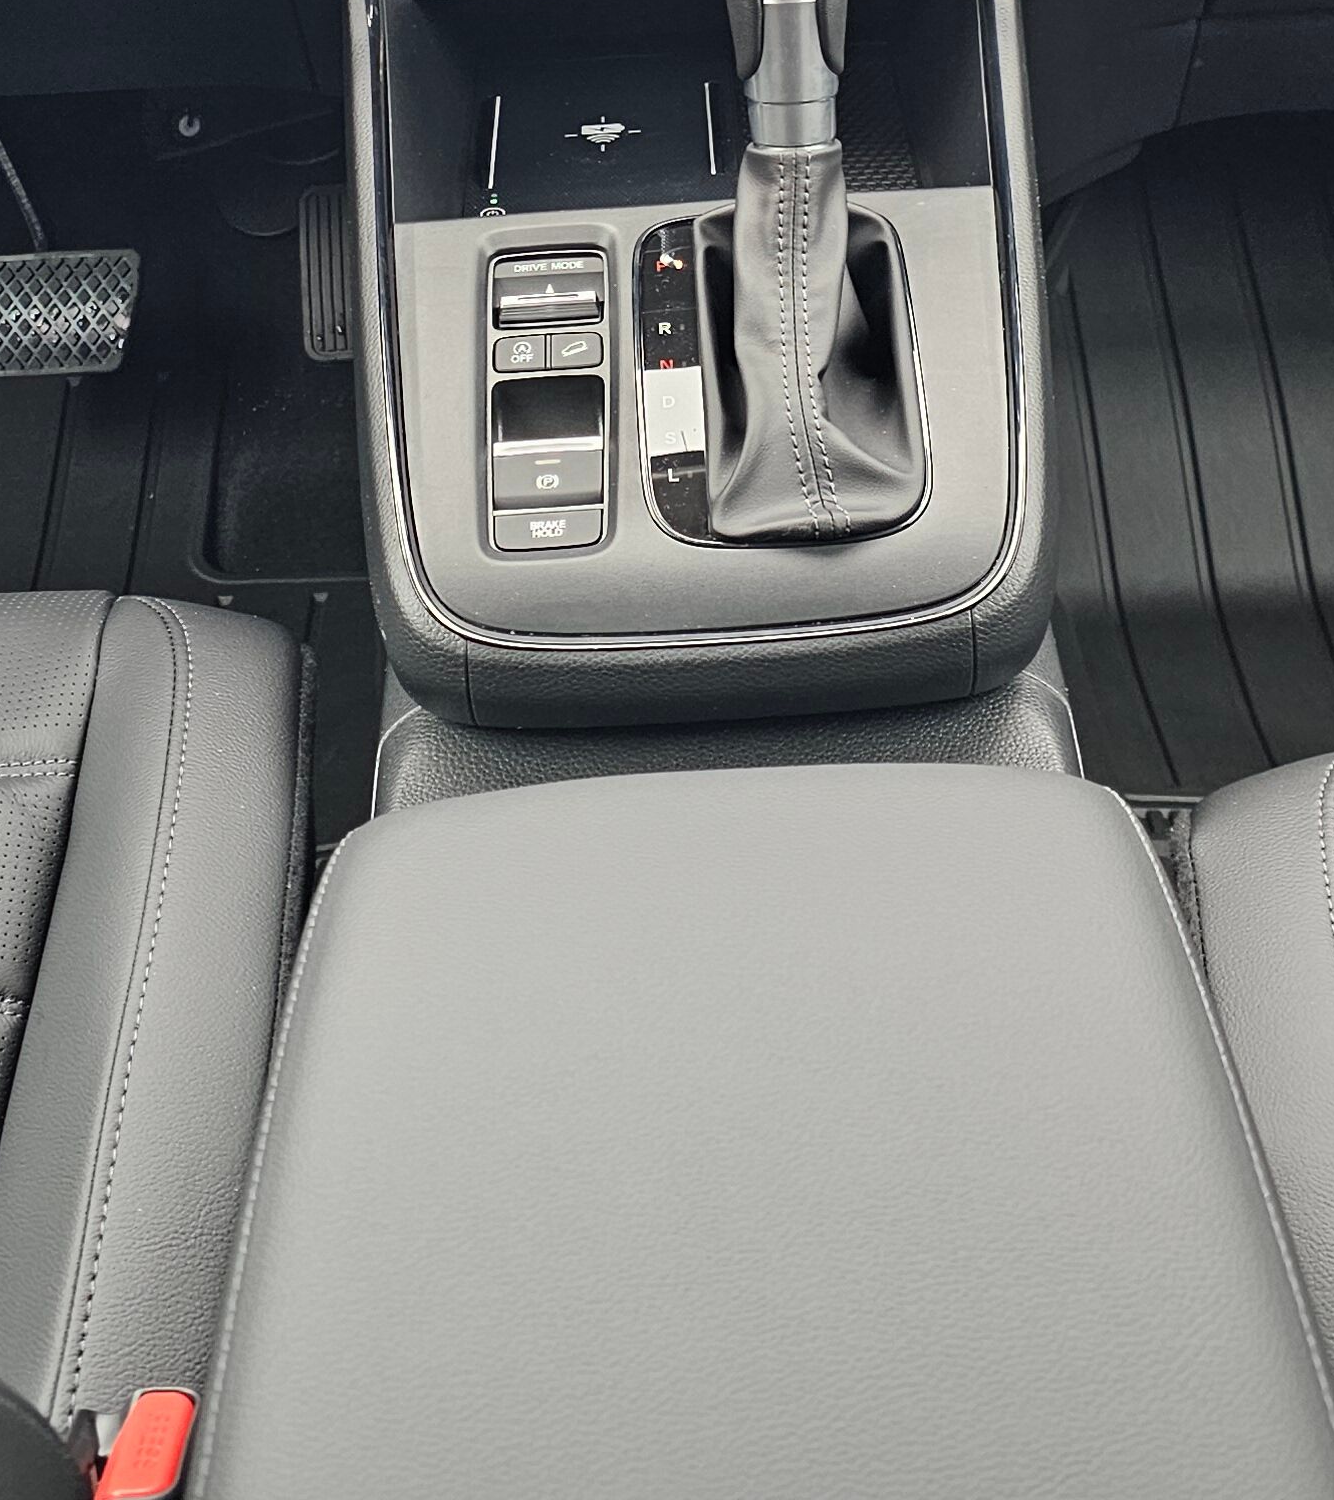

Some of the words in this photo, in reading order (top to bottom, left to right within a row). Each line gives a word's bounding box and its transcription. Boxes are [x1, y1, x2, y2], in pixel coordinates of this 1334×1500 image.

[513, 261, 547, 273] DRIVE
[550, 260, 584, 271] MODE
[658, 322, 672, 335] R
[510, 352, 534, 364] OFF
[660, 359, 674, 371] N
[662, 396, 675, 409] D
[664, 432, 677, 445] S
[668, 469, 680, 483] L
[530, 520, 567, 531] BRAKE
[532, 528, 563, 539] HOLD
